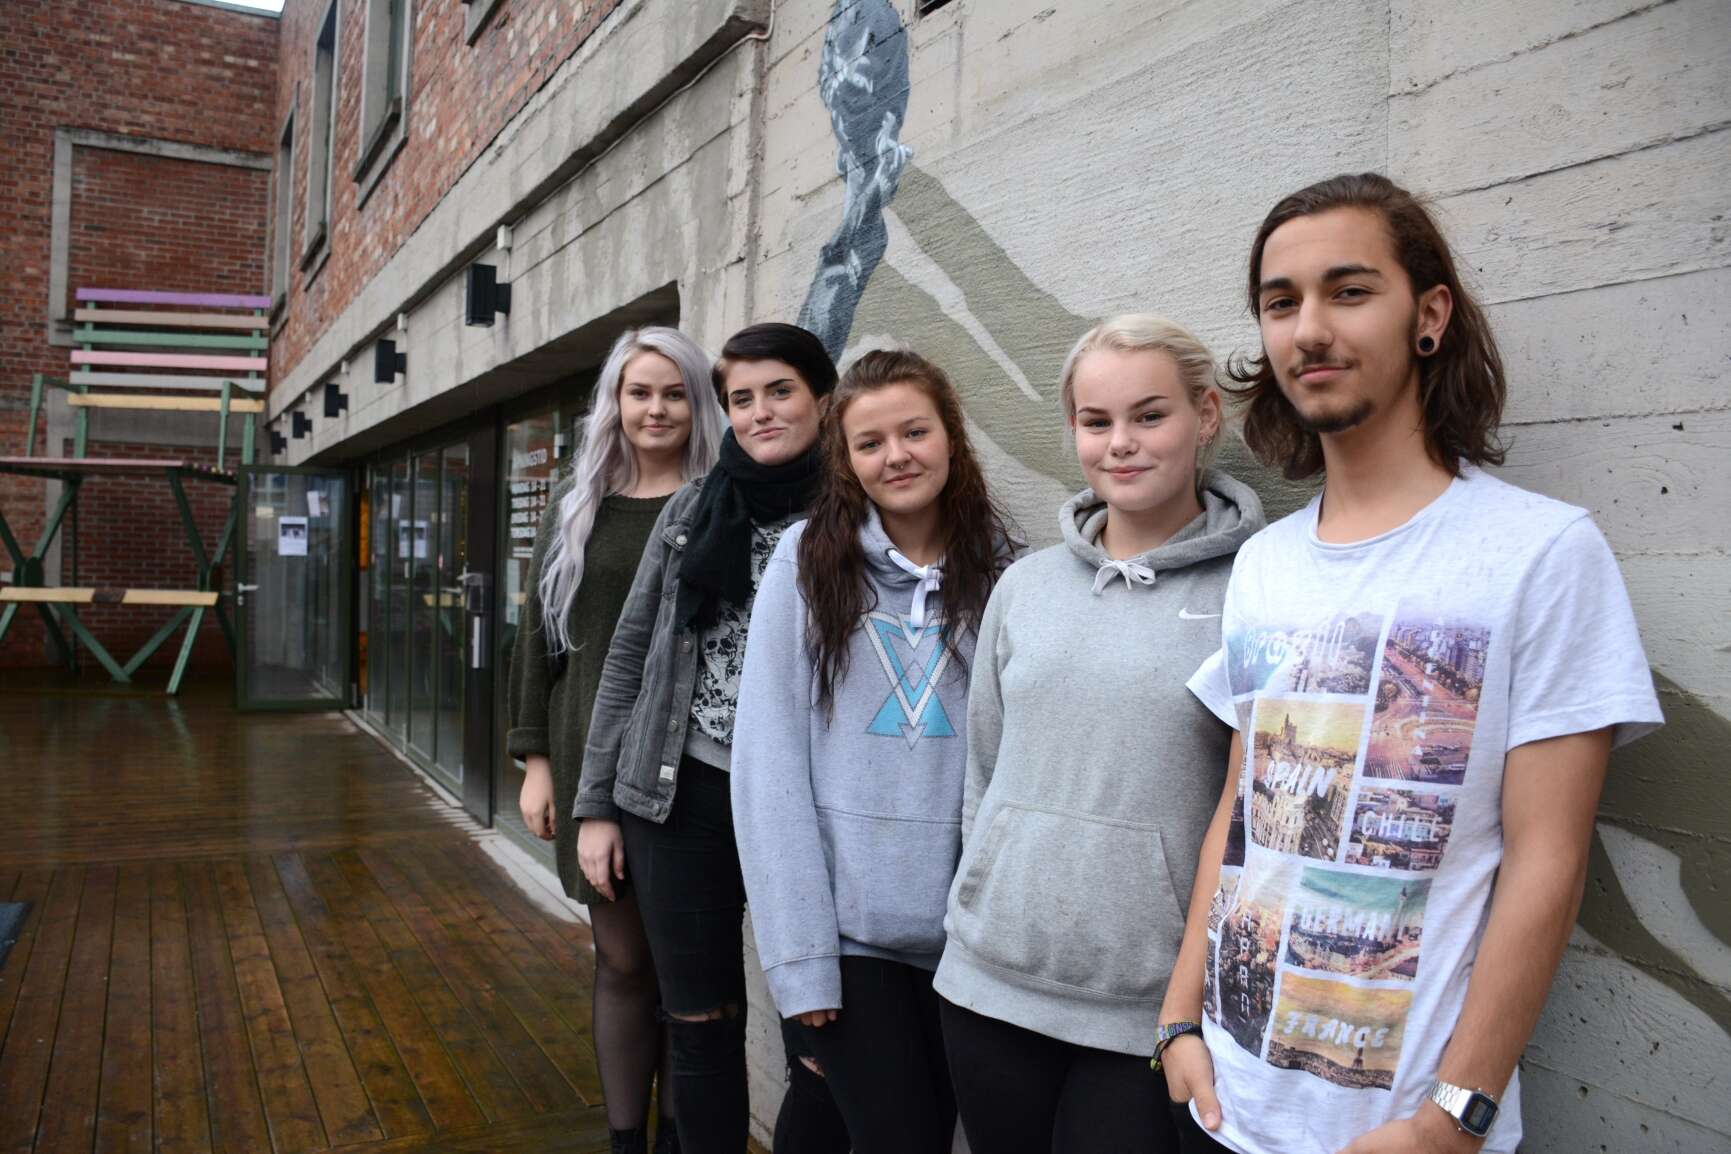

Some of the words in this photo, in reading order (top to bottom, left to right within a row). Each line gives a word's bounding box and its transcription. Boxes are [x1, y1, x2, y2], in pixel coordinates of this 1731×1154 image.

[1264, 760, 1337, 798] SPAIN
[1362, 811, 1441, 841] CHILE
[1283, 1011, 1389, 1047] FRANCE
